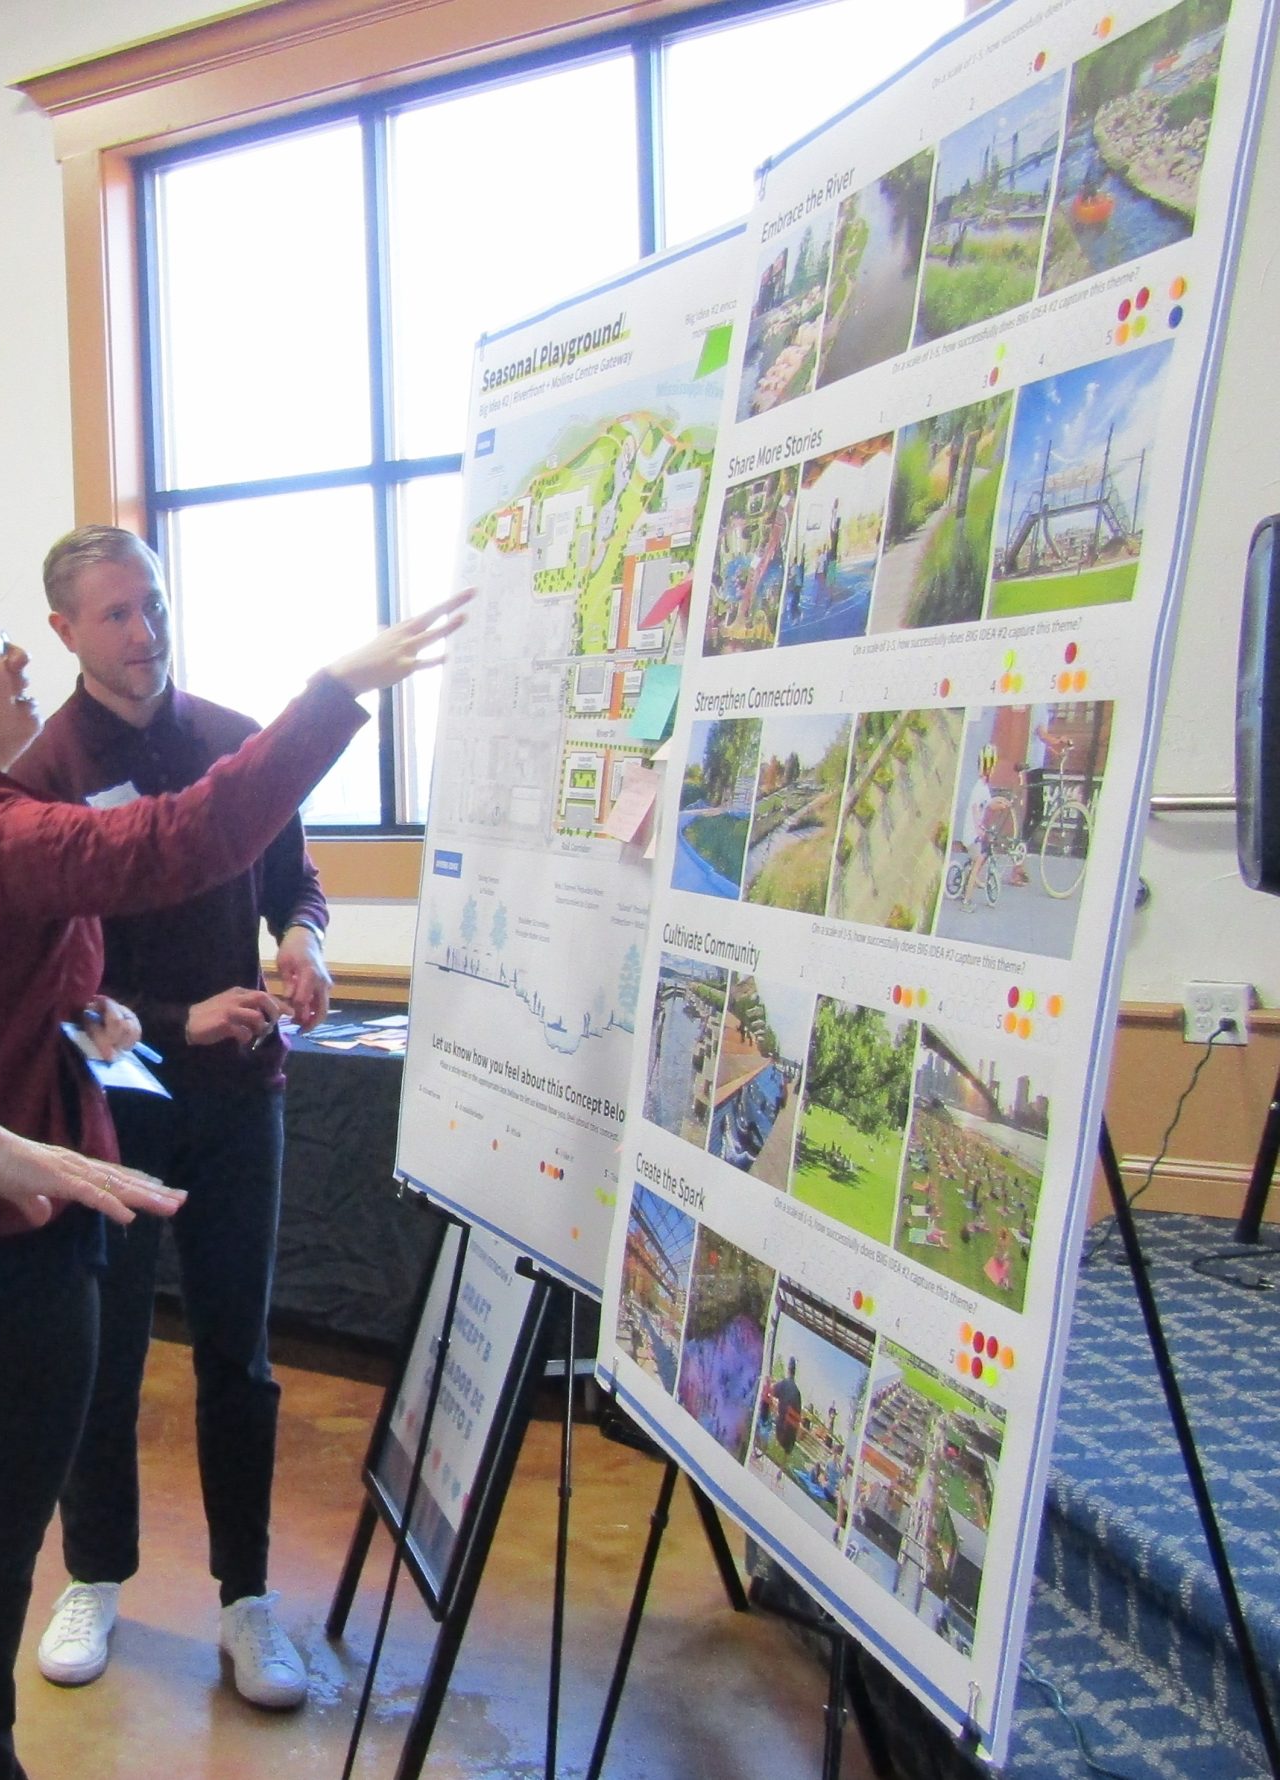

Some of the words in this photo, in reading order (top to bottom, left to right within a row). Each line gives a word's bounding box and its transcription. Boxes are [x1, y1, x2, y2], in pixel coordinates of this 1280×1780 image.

[761, 202, 804, 243] Embrace
[806, 188, 823, 214] the
[825, 167, 856, 202] River
[482, 348, 537, 392] Seasonal
[513, 383, 546, 403] Riverfront
[551, 373, 574, 391] Moline
[574, 363, 599, 382] Centre
[600, 350, 633, 373] Gateway
[926, 393, 932, 408] 2
[982, 374, 989, 389] 3
[1038, 352, 1046, 367] 4
[1105, 329, 1113, 346] 5
[727, 457, 754, 479] Share
[756, 443, 781, 469] More
[784, 428, 824, 459] Stories
[965, 629, 979, 643] BIG
[979, 627, 998, 641] IDEA
[1008, 624, 1036, 641] capture
[1036, 620, 1051, 635] this
[694, 687, 746, 717] Strengthen
[747, 682, 815, 710] Connections
[883, 686, 889, 700] 2
[932, 682, 938, 697] 3
[990, 679, 997, 694] 4
[1050, 674, 1057, 690] 5
[663, 923, 703, 952] Cultivate
[704, 932, 760, 973] Community
[900, 940, 917, 954] does
[917, 942, 929, 956] BIG
[929, 945, 945, 960] IDEA
[955, 952, 981, 967] capture
[982, 953, 996, 970] this
[997, 957, 1026, 976] theme?
[886, 986, 892, 1001] 3
[995, 1014, 1003, 1030] 5
[432, 1033, 443, 1051] Let
[444, 1041, 452, 1055] us
[453, 1040, 472, 1062] know
[472, 1048, 488, 1069] how
[489, 1058, 504, 1075] you
[505, 1060, 520, 1081] feel
[521, 1068, 546, 1092] about
[547, 1078, 564, 1099] this
[565, 1085, 602, 1116] Concept
[603, 1099, 626, 1123] Belo
[636, 1152, 661, 1185] Create
[662, 1167, 678, 1194] the
[678, 1177, 707, 1212] Spark
[860, 1244, 876, 1261] does
[876, 1250, 888, 1267] BIG
[888, 1257, 901, 1274] IDEA
[910, 1272, 936, 1294] capture
[936, 1284, 950, 1301] this
[950, 1291, 978, 1315] theme?
[846, 1287, 851, 1301] 3
[948, 1348, 955, 1364] 5
